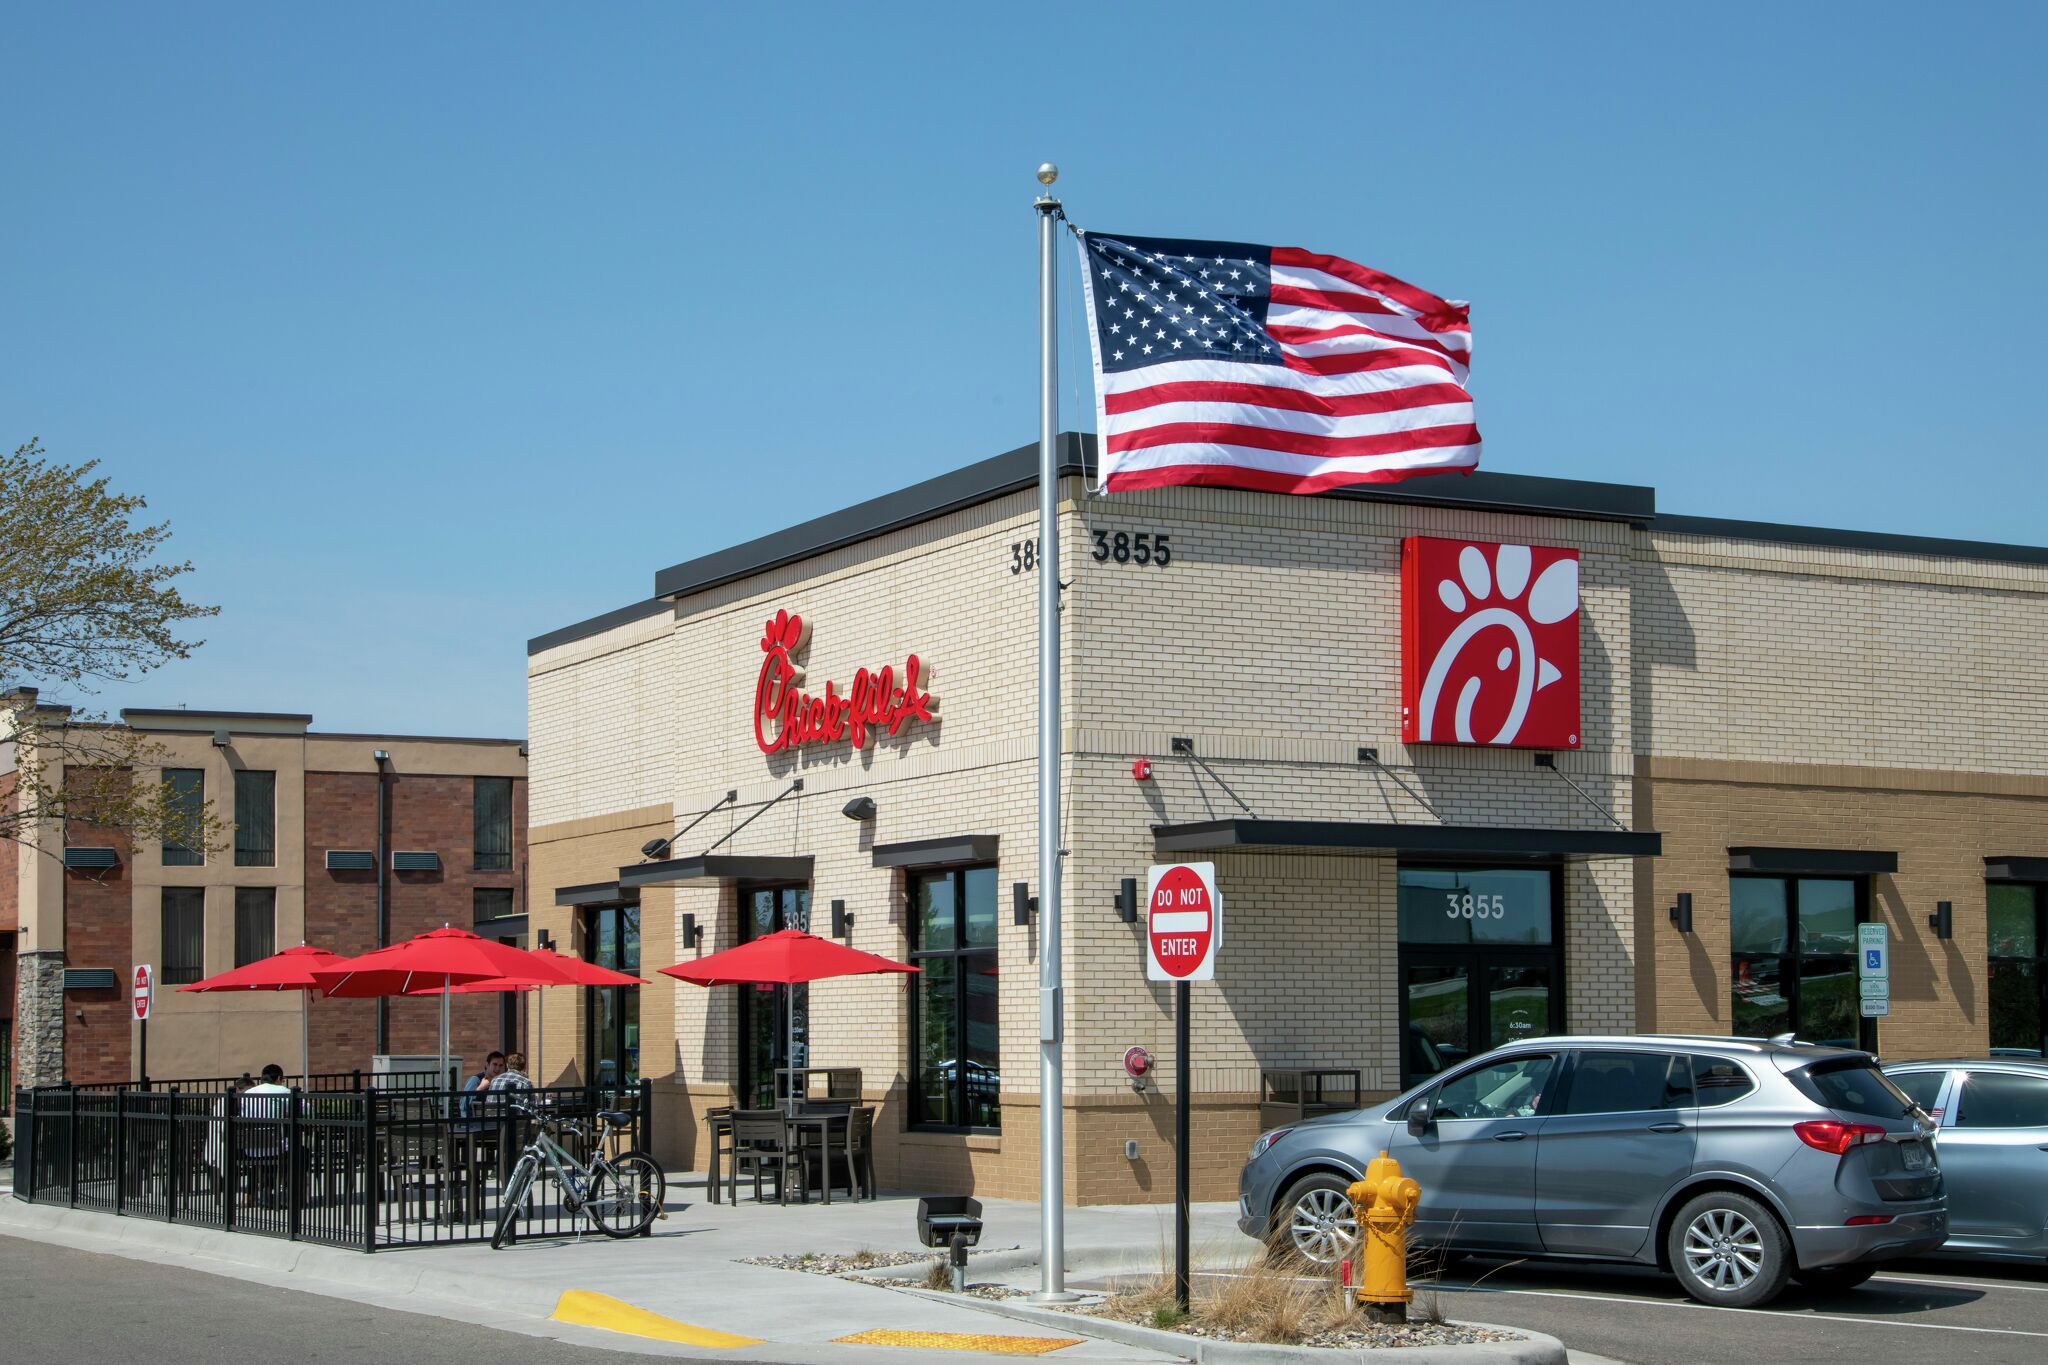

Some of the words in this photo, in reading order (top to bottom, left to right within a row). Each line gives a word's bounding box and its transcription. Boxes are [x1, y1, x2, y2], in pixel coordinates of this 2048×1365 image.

[1010, 537, 1040, 575] 38
[1091, 530, 1171, 566] 3855
[1157, 889, 1173, 906] DO
[1180, 888, 1203, 905] NOT
[1446, 894, 1504, 919] 3855
[784, 910, 810, 932] 385
[1161, 938, 1197, 956] ENTER
